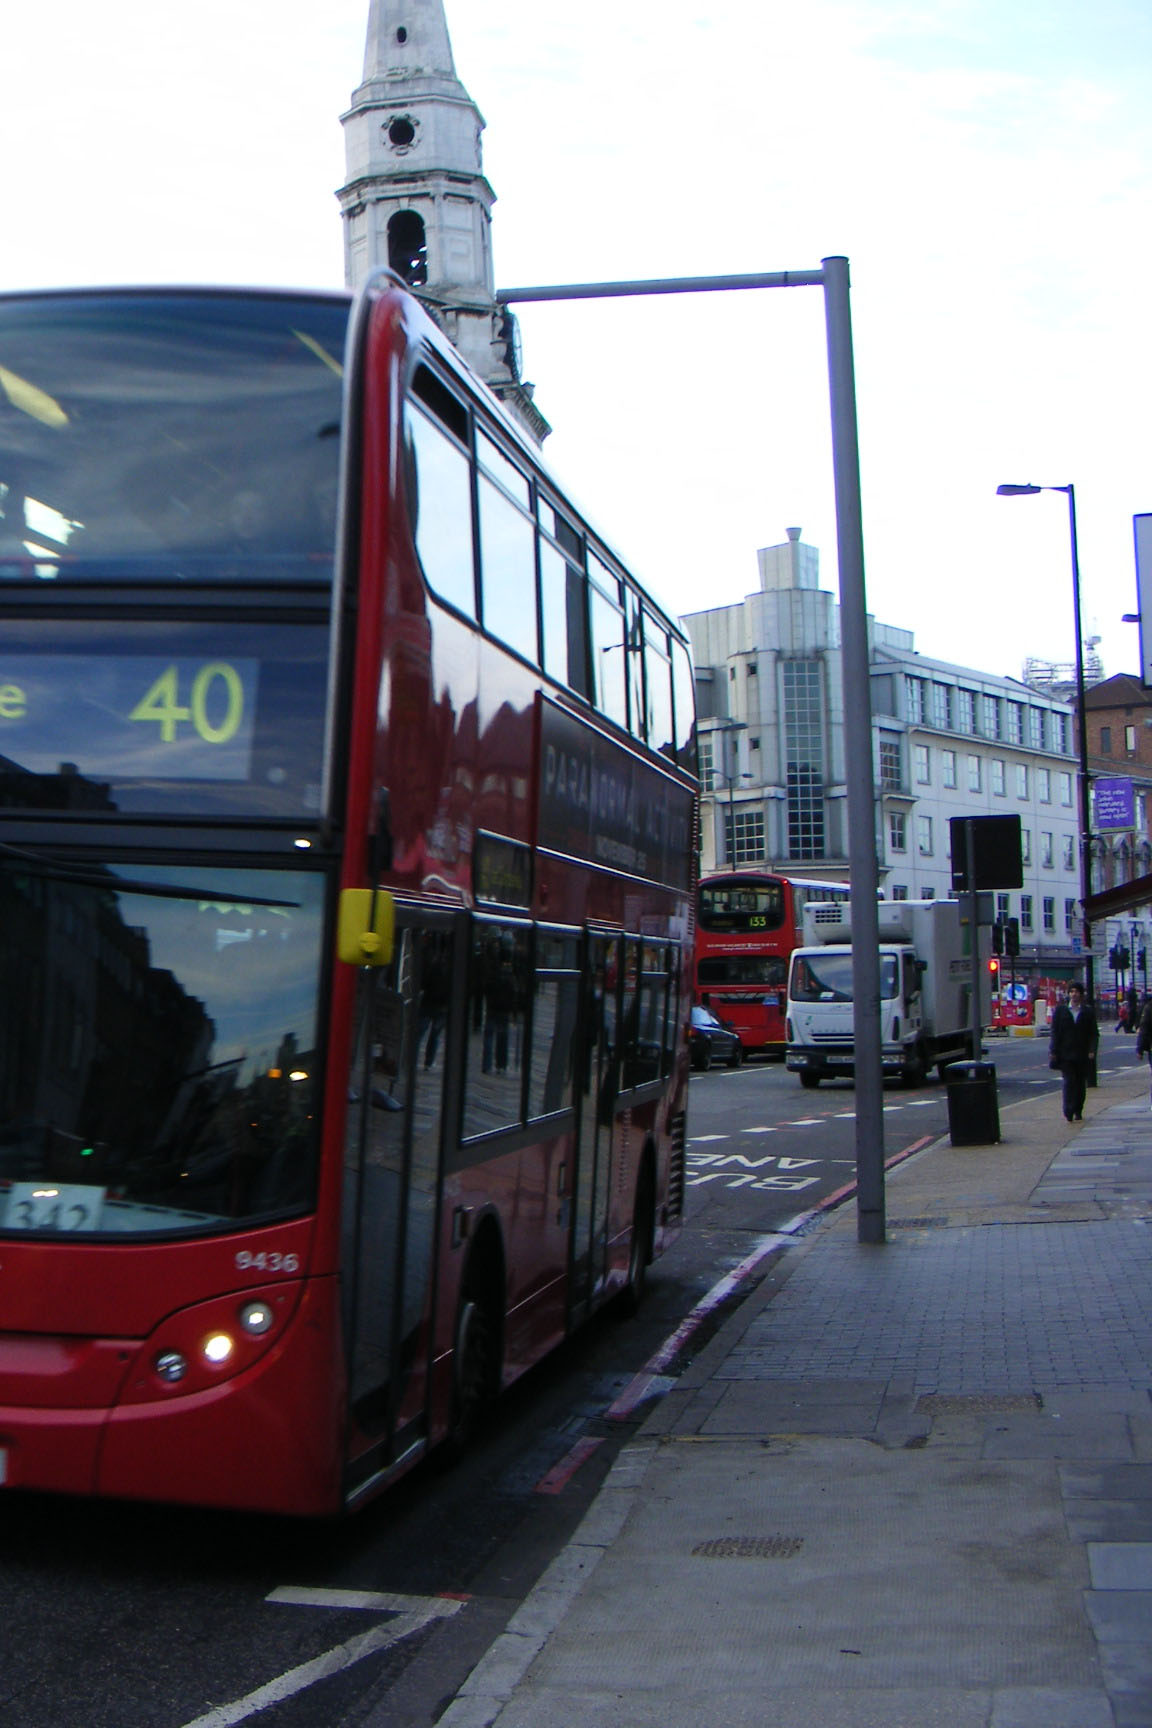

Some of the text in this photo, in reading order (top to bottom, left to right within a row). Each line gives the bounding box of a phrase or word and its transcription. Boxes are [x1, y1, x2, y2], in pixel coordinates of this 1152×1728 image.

[128, 661, 245, 744] 40
[749, 915, 767, 928] 133
[686, 1171, 822, 1190] BU
[13, 1199, 89, 1231] 342
[234, 1250, 299, 1273] 9436
